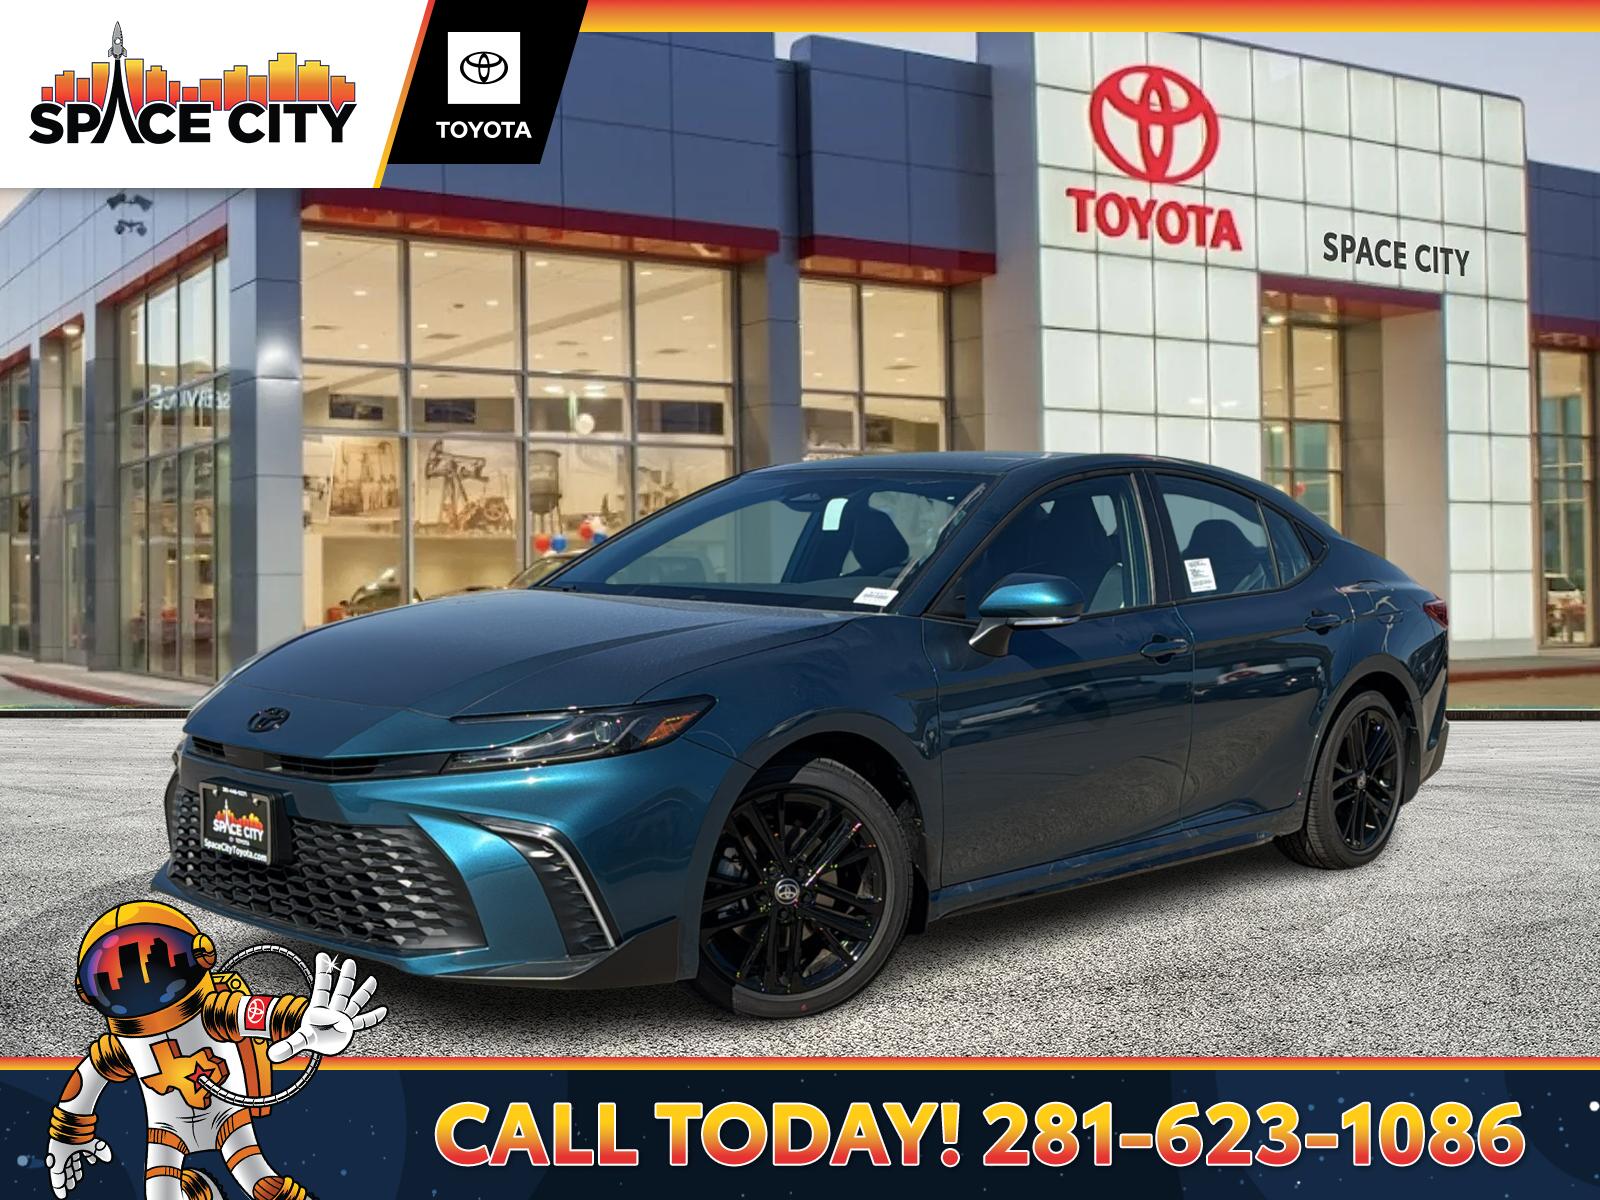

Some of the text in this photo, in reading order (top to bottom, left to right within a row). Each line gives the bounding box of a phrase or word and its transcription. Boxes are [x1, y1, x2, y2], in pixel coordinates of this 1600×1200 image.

[1066, 187, 1242, 251] TOYOTA
[1323, 231, 1471, 277] SPACE CITY
[204, 838, 267, 862] SpaceCityToyota.com
[243, 825, 264, 842] CITY
